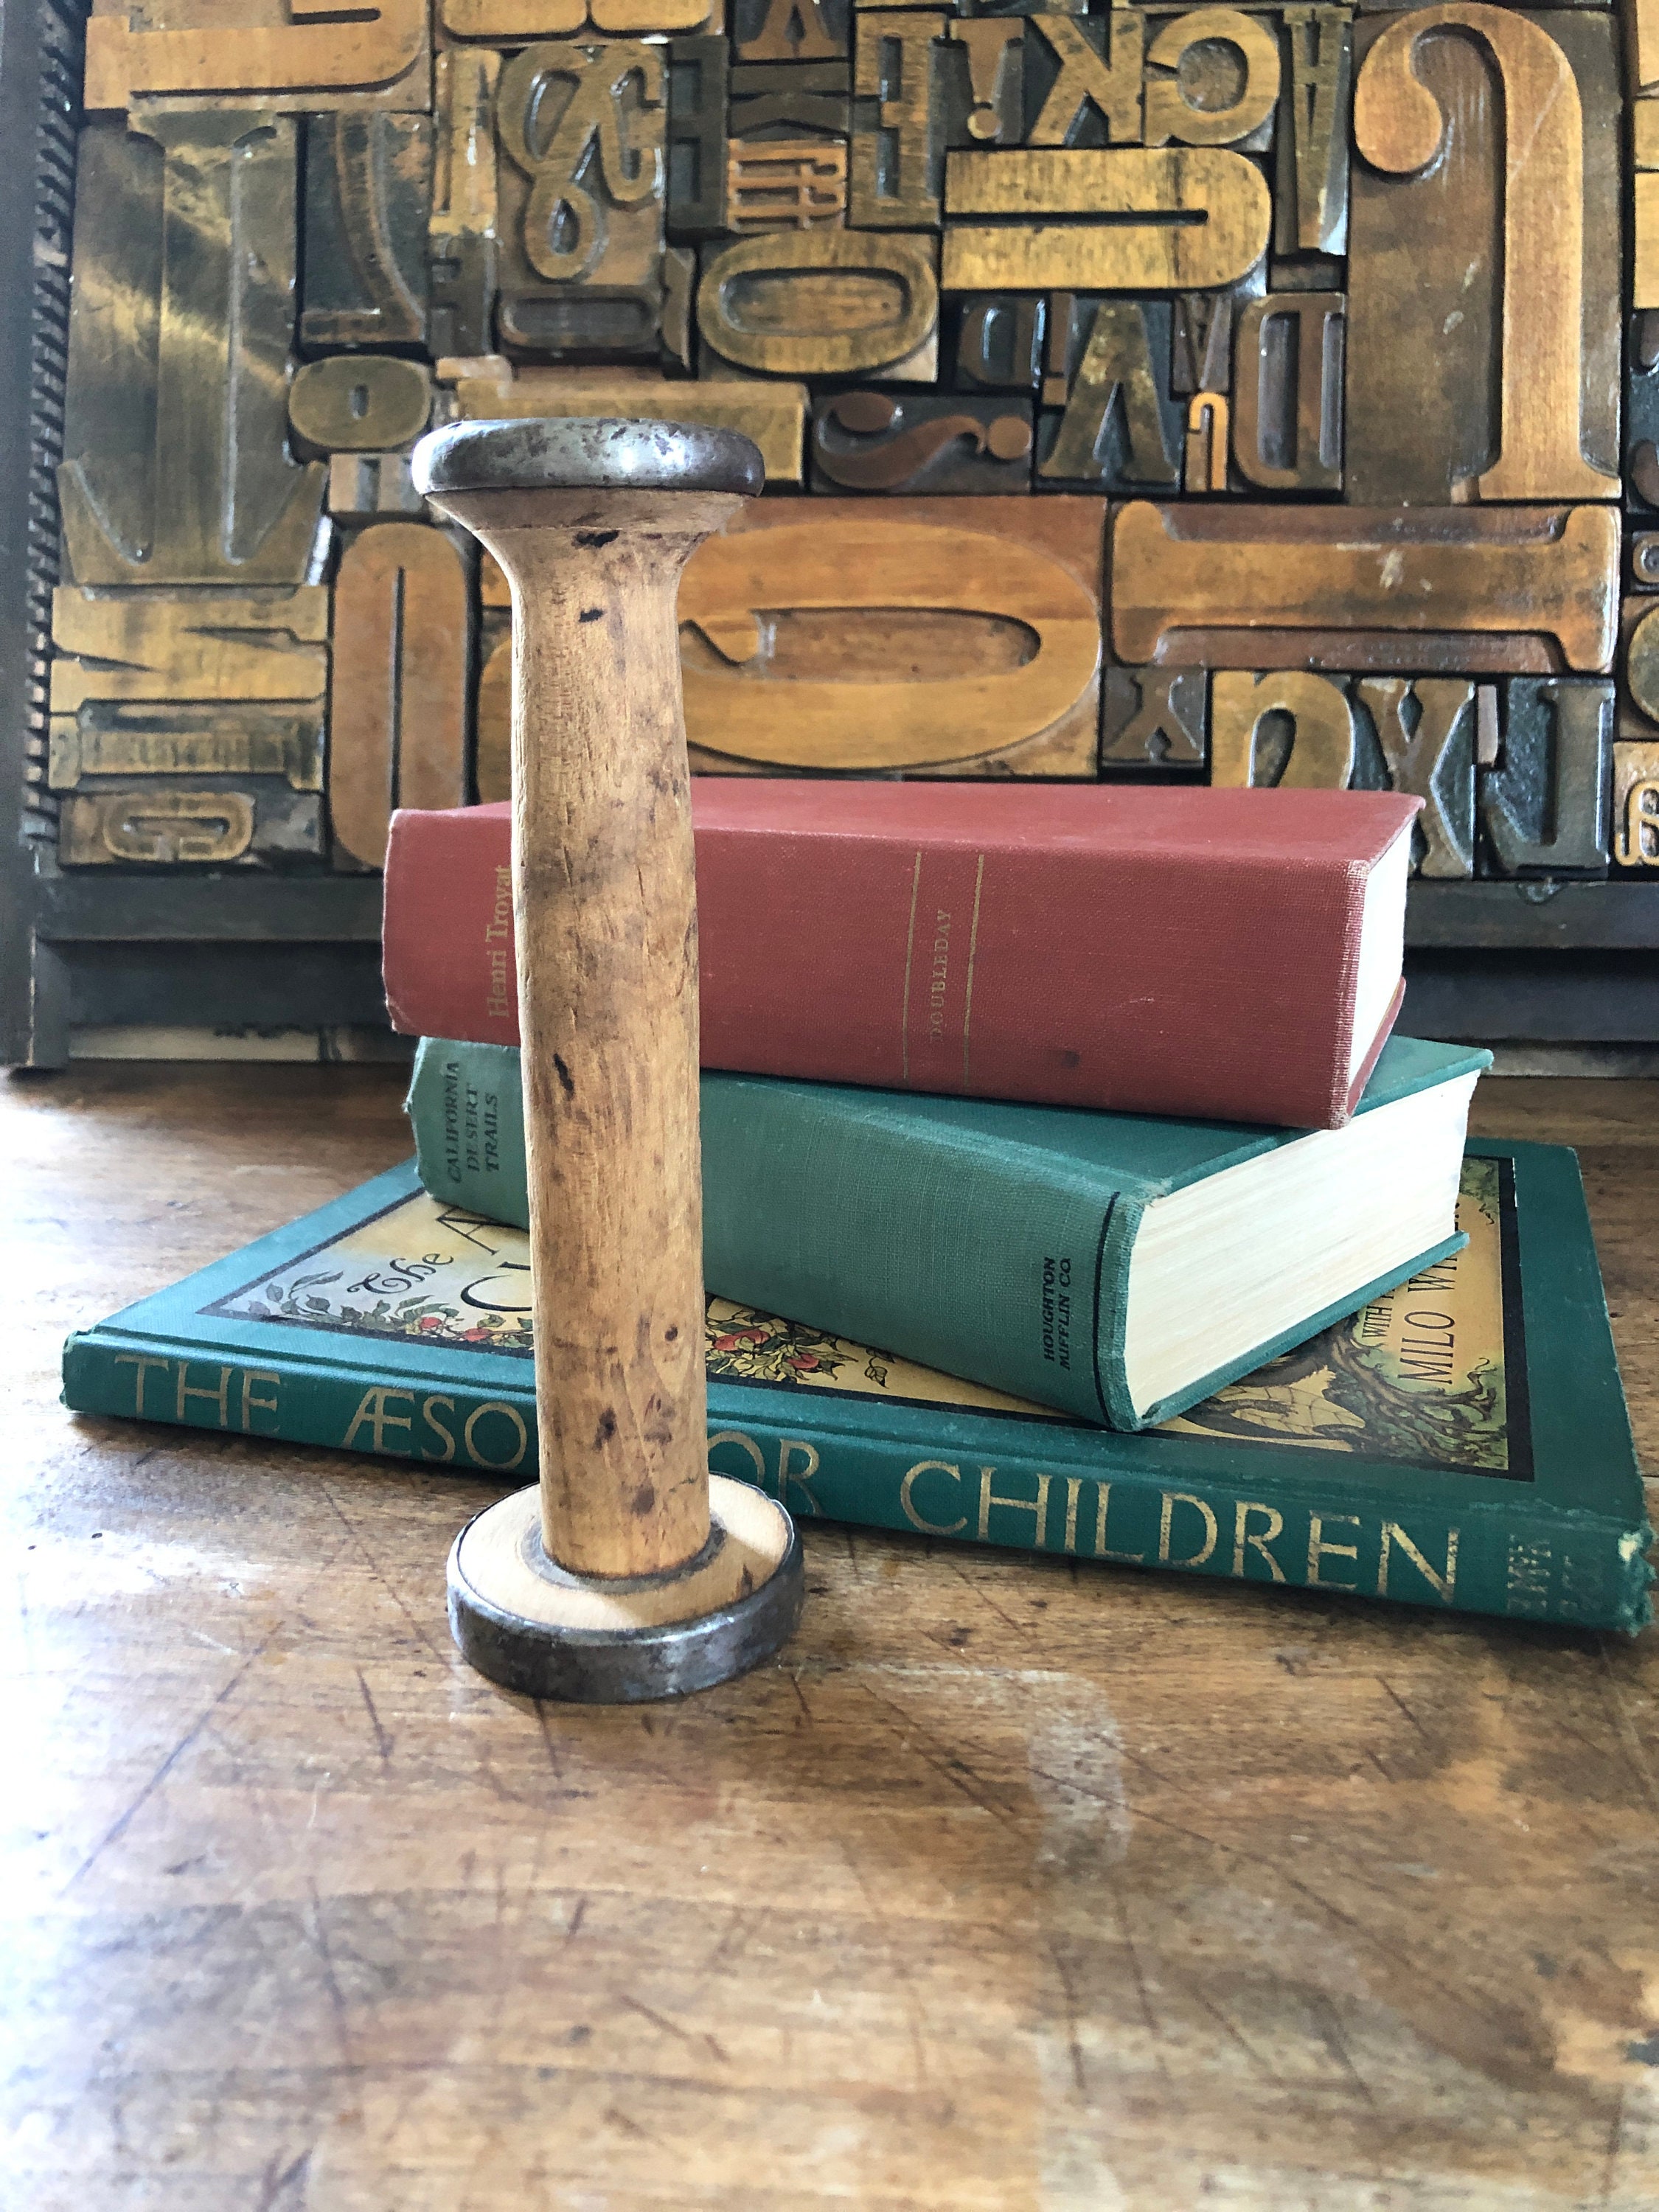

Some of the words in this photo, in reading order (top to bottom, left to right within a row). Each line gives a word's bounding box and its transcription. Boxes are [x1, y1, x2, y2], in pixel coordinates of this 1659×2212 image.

[485, 864, 512, 943] Troyat
[487, 950, 510, 1018] Henri
[930, 908, 951, 1043] DOUBLEDAY
[445, 1061, 462, 1183] CALIFORNIA
[466, 1082, 479, 1172] DESERT
[484, 1091, 500, 1172] TRAILS
[1043, 1256, 1056, 1362] HOUGHTON
[1058, 1293, 1071, 1371] MIFFLIN
[1362, 1304, 1393, 1338] WITH
[1397, 1310, 1456, 1385] MILO
[114, 1354, 281, 1435] THE
[341, 1386, 529, 1470] ÆSO
[900, 1460, 1461, 1604] CHILDREN
